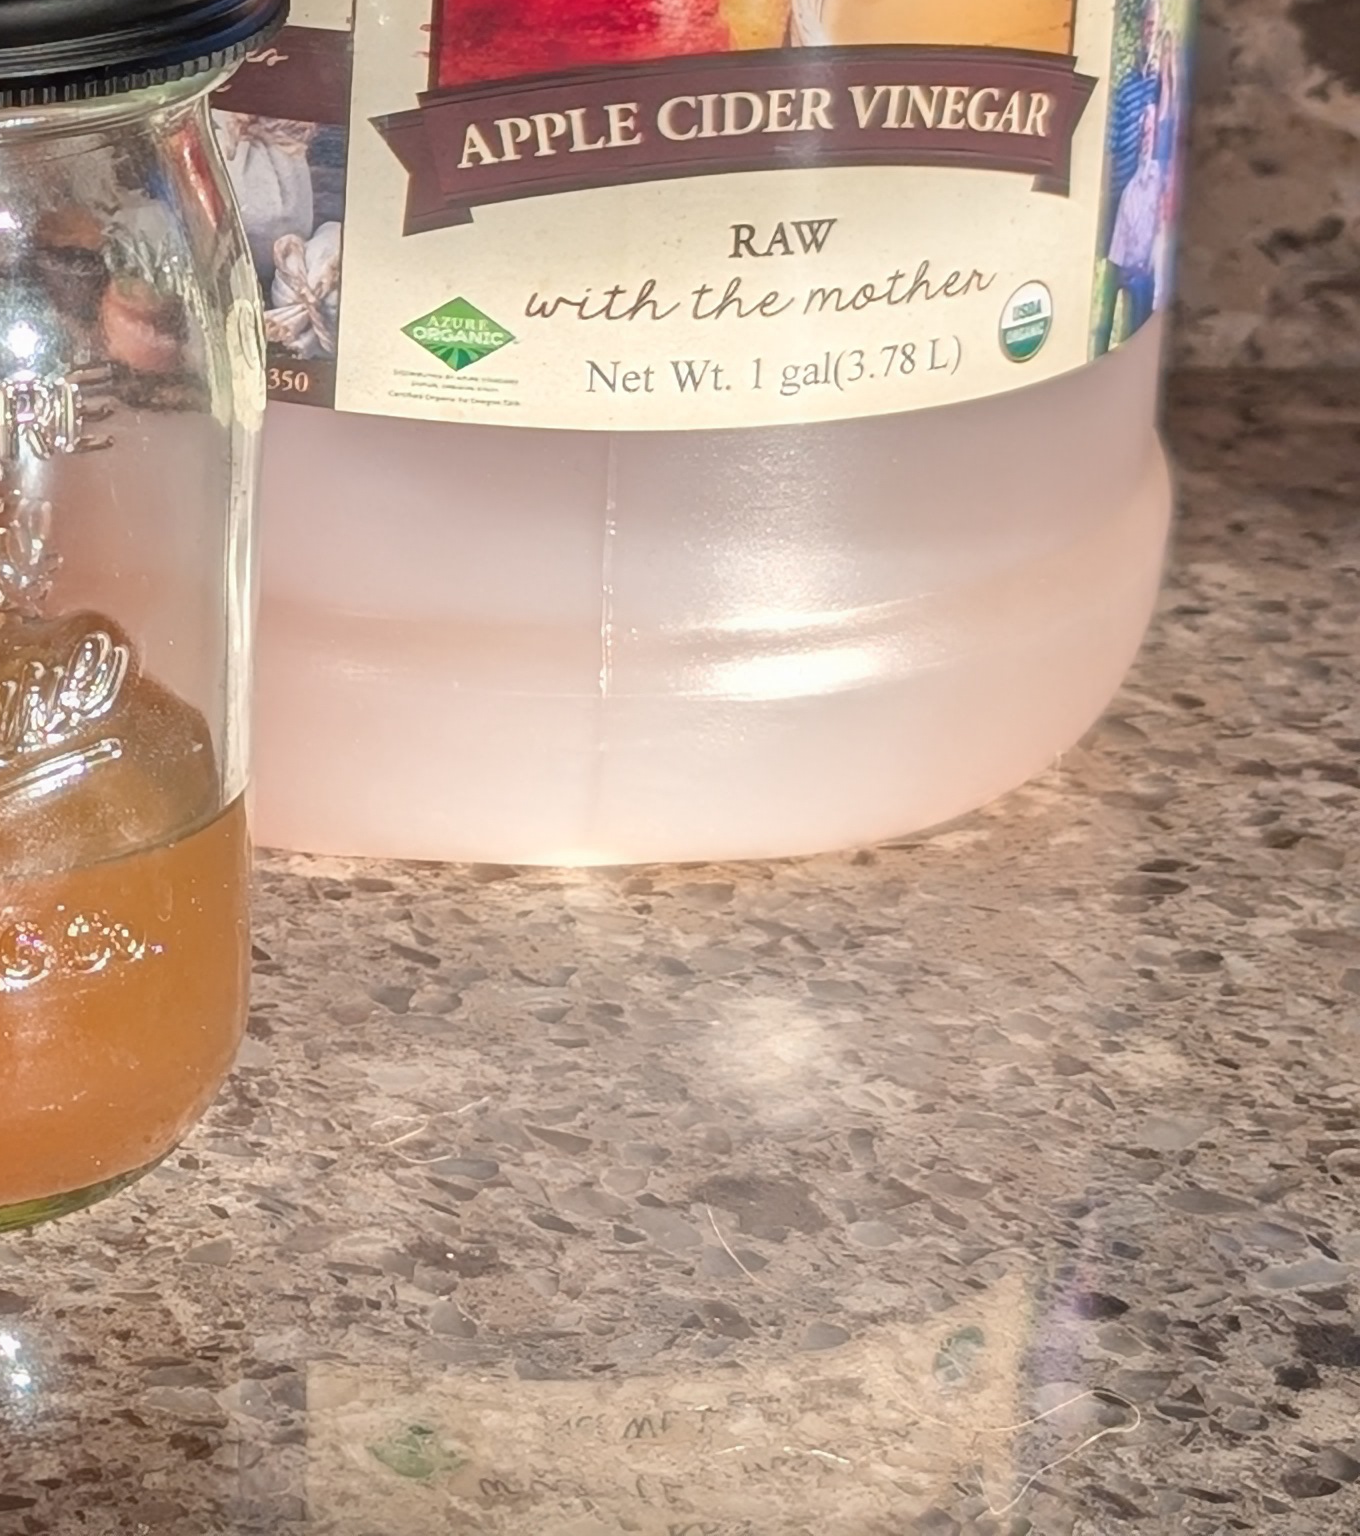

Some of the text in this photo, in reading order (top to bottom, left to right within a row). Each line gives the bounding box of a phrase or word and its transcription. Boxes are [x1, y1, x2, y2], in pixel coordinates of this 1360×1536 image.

[456, 84, 1052, 169] APPLE CIDER VINEGAR
[728, 218, 837, 258] RAW
[524, 259, 999, 322] with the mother
[411, 326, 505, 347] ORGANIC
[426, 314, 490, 331] AZURE
[584, 334, 964, 397] Net Wt. 1 gal(3.78 L)
